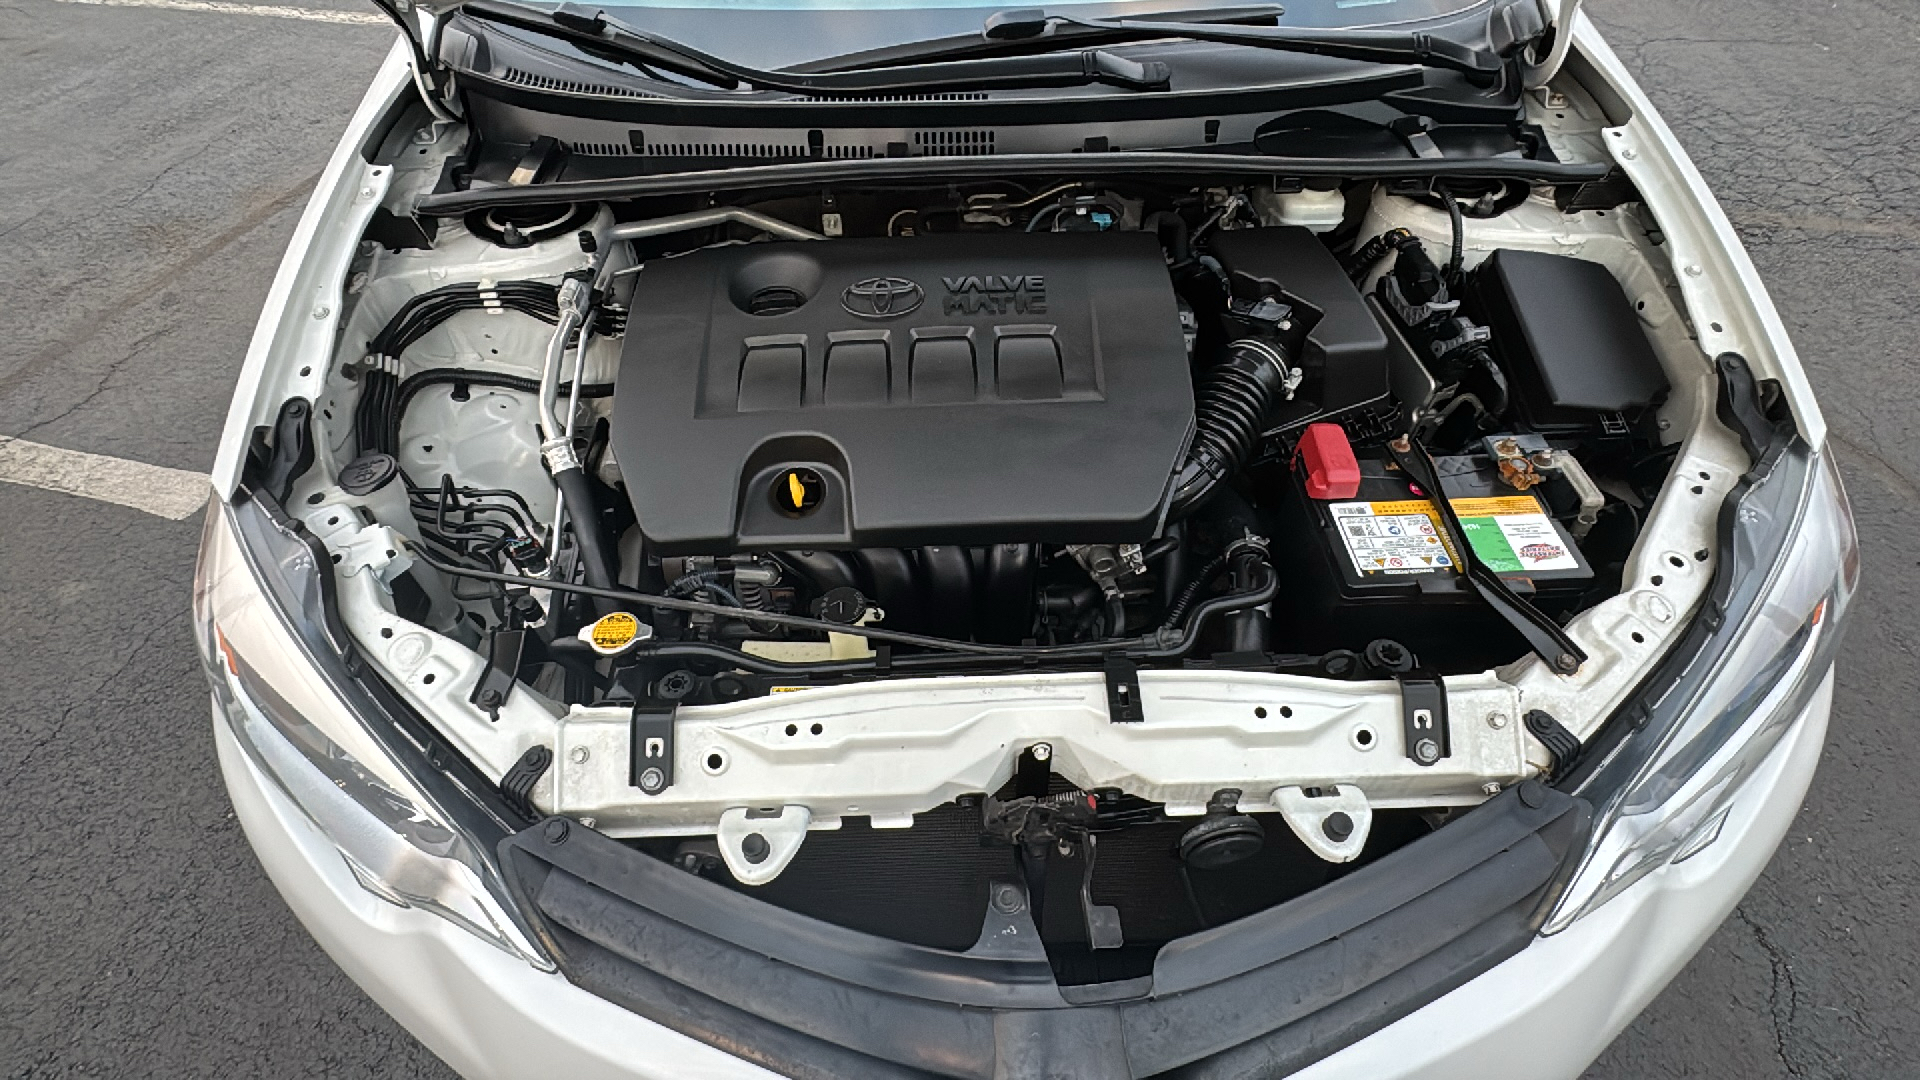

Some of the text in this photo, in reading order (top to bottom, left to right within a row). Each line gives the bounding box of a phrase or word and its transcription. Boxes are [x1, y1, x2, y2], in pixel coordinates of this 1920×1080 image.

[941, 275, 1045, 293] VALVE
[941, 293, 1048, 315] MATIC
[1519, 550, 1565, 558] INTERSTATE
